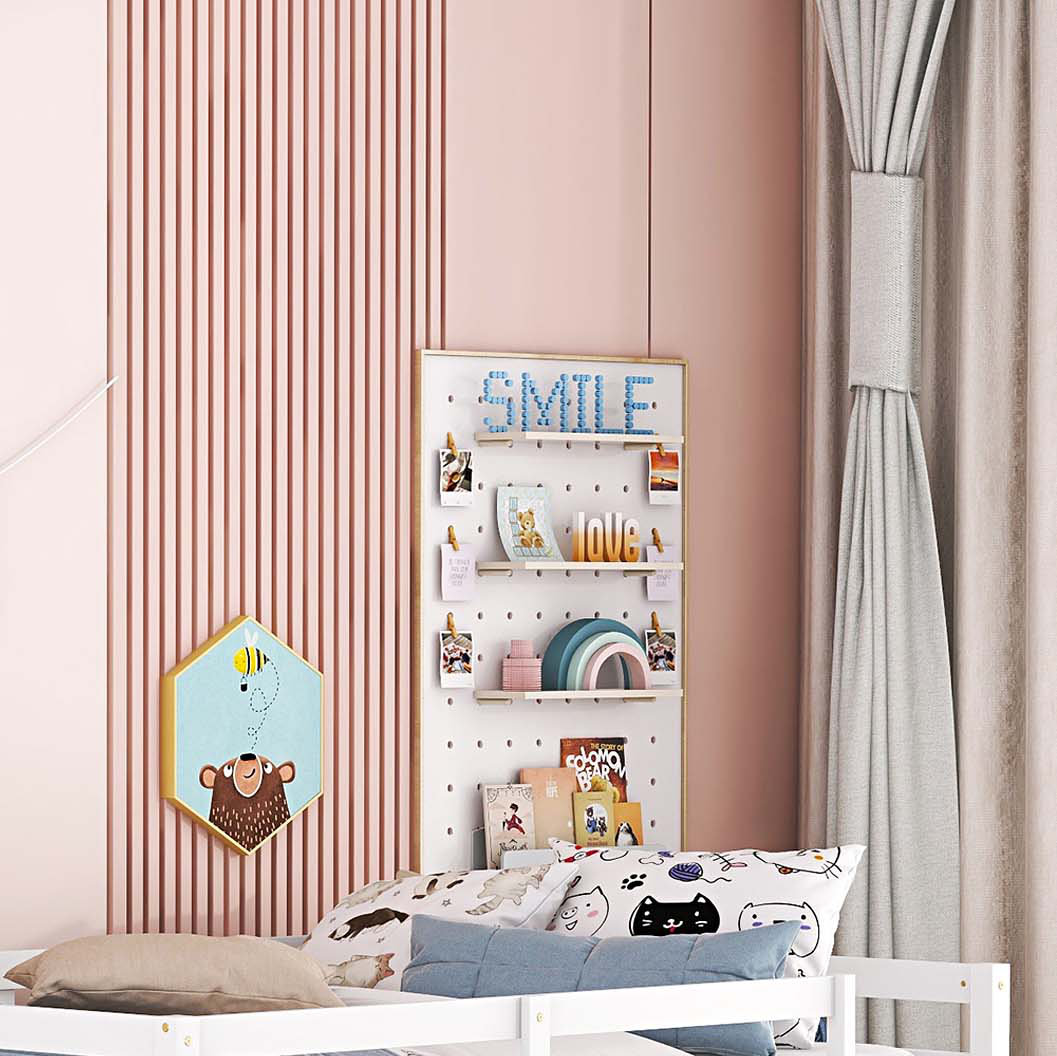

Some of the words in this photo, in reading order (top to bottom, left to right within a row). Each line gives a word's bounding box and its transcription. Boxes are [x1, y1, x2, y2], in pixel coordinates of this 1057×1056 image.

[482, 370, 655, 434] SMILE
[572, 511, 641, 562] love
[577, 763, 610, 792] BEAR
